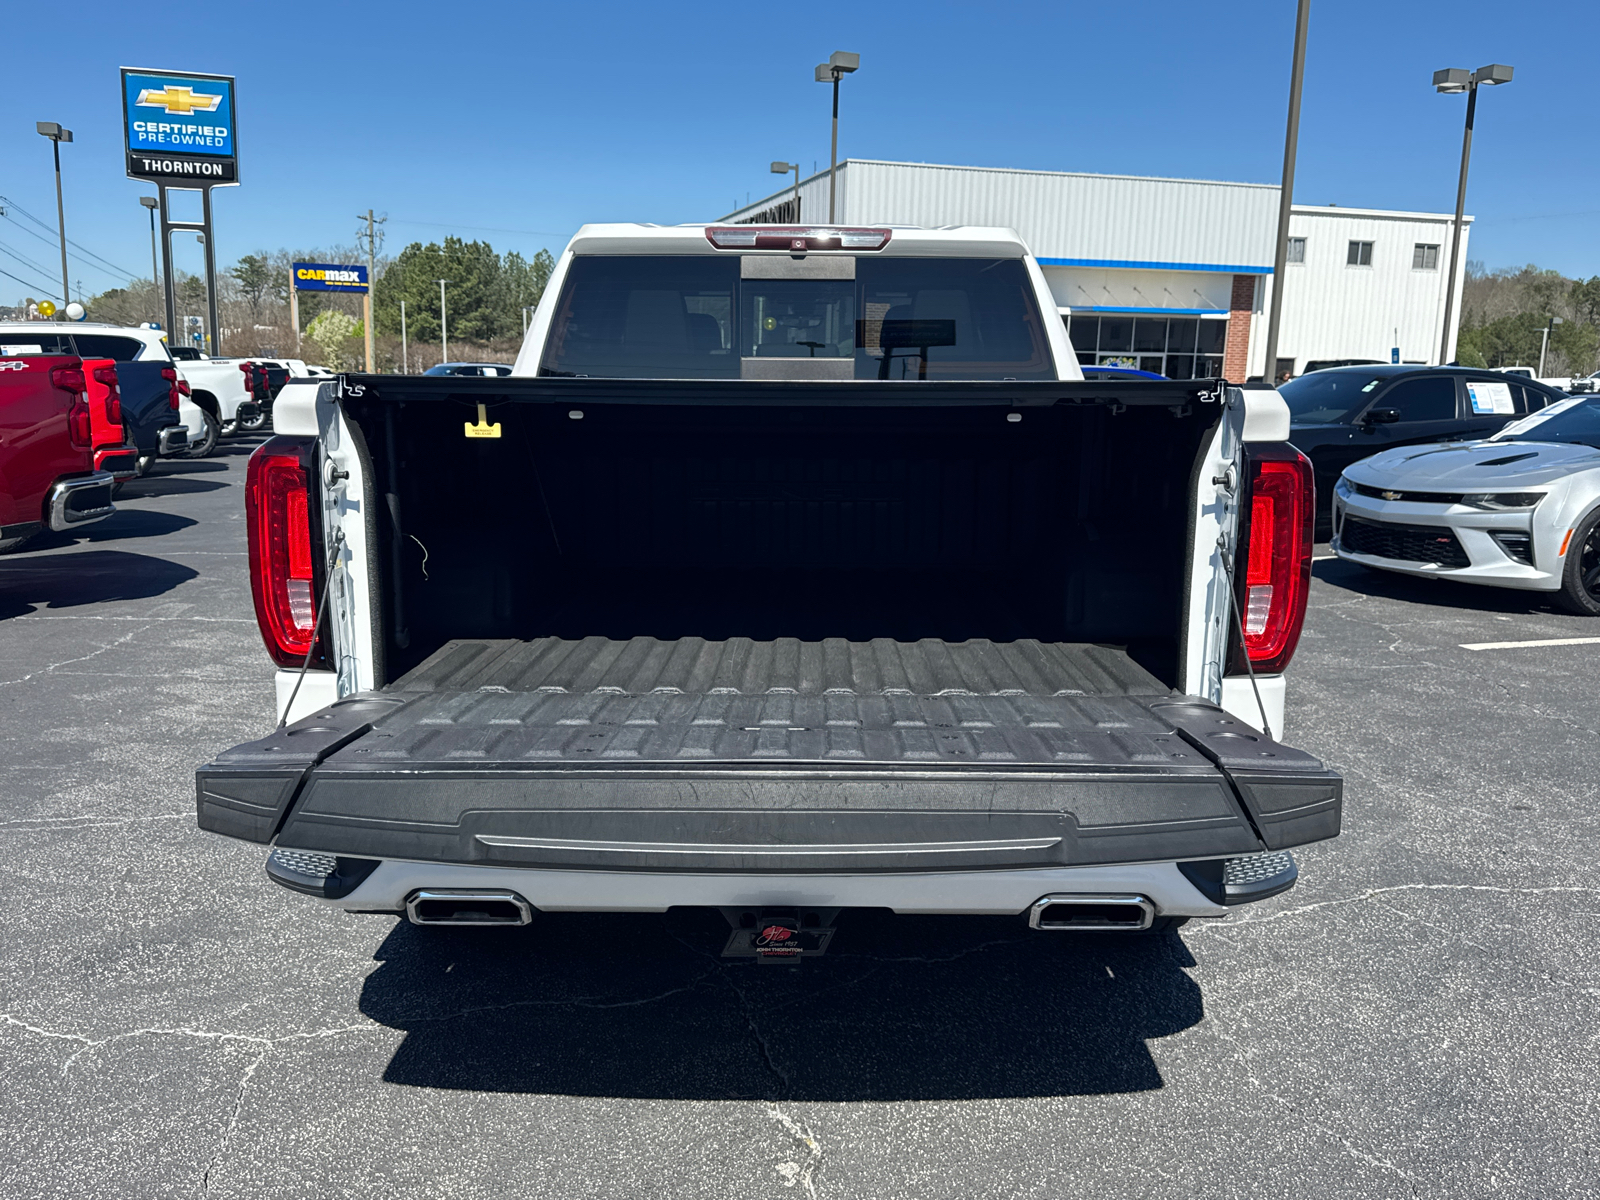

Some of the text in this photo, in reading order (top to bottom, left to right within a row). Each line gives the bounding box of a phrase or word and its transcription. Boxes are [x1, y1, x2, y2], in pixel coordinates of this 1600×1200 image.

[133, 121, 228, 137] CERTIFIED
[139, 132, 224, 147] PRE-OWNED
[142, 159, 223, 176] THORNTON
[297, 268, 360, 282] CARmax
